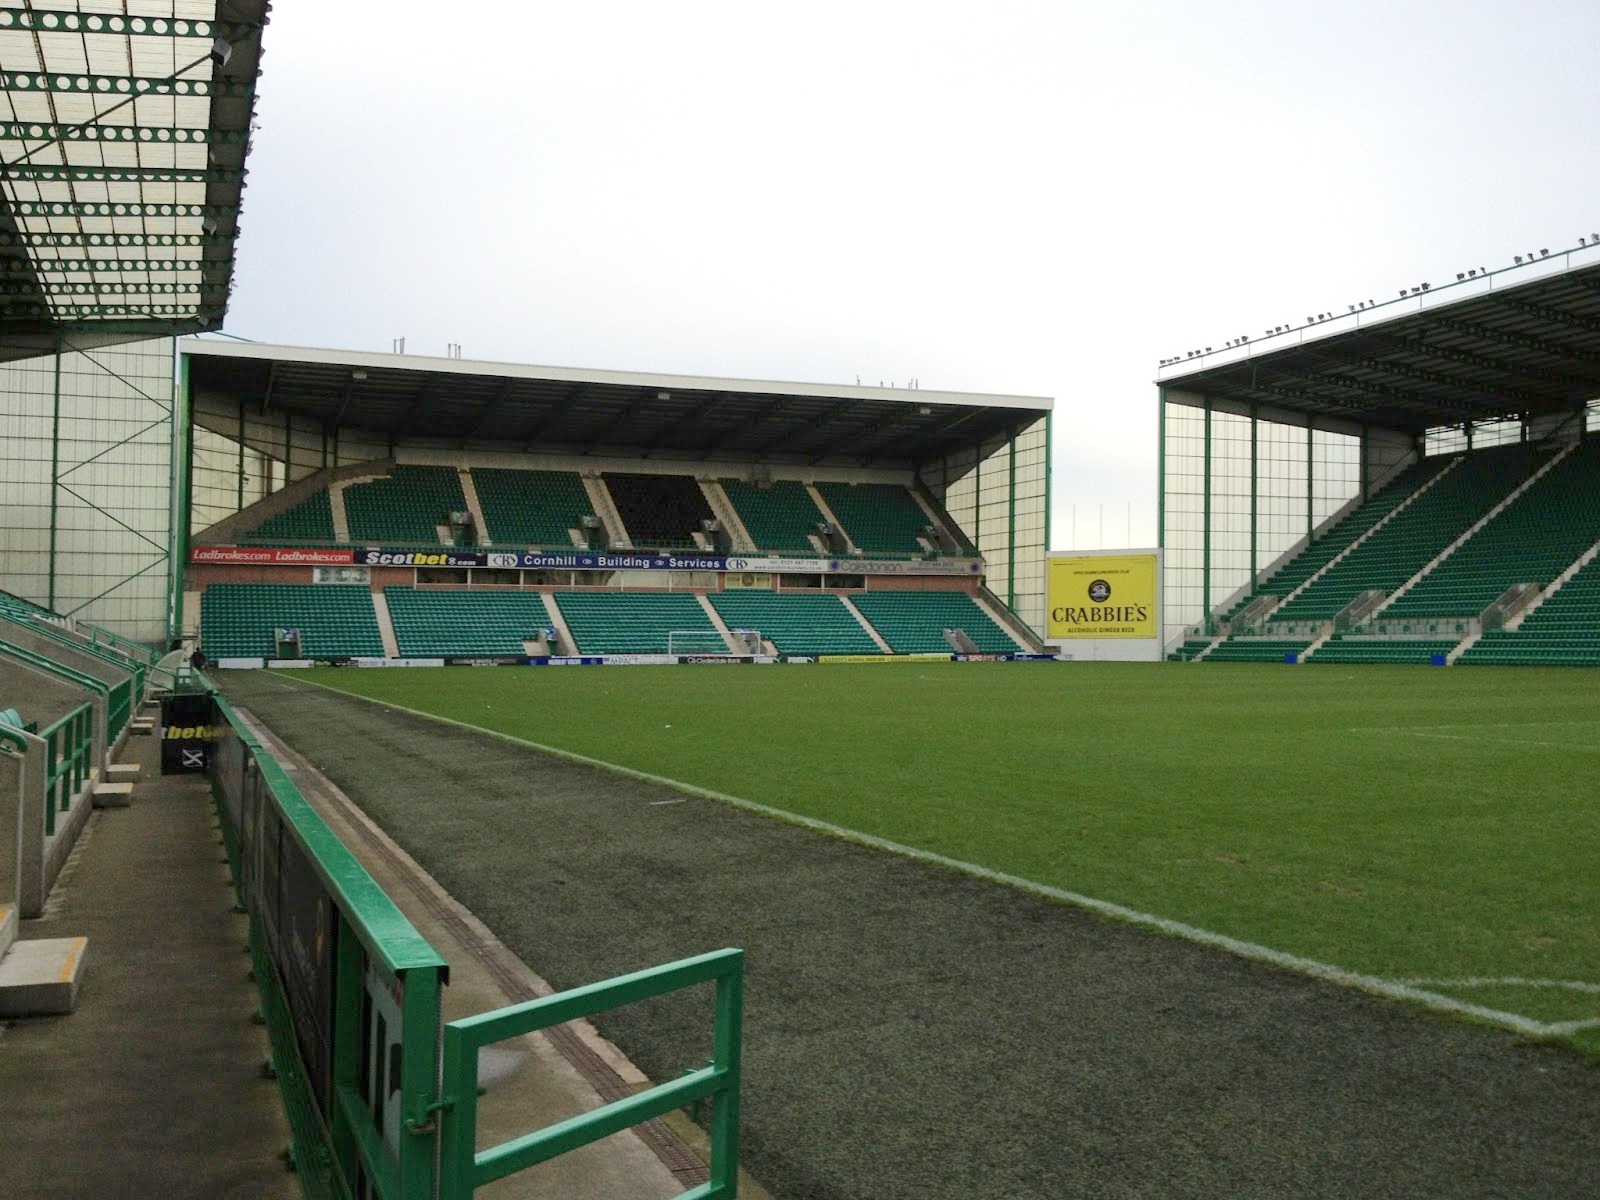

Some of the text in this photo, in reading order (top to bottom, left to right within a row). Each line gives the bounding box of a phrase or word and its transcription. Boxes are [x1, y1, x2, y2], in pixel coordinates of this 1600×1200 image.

[193, 549, 350, 562] Ladbrokes.com Ladbrokes.com
[524, 555, 576, 565] Cornhill
[598, 556, 650, 568] Building
[669, 557, 720, 568] Services
[1052, 603, 1147, 624] CRABBIE'S
